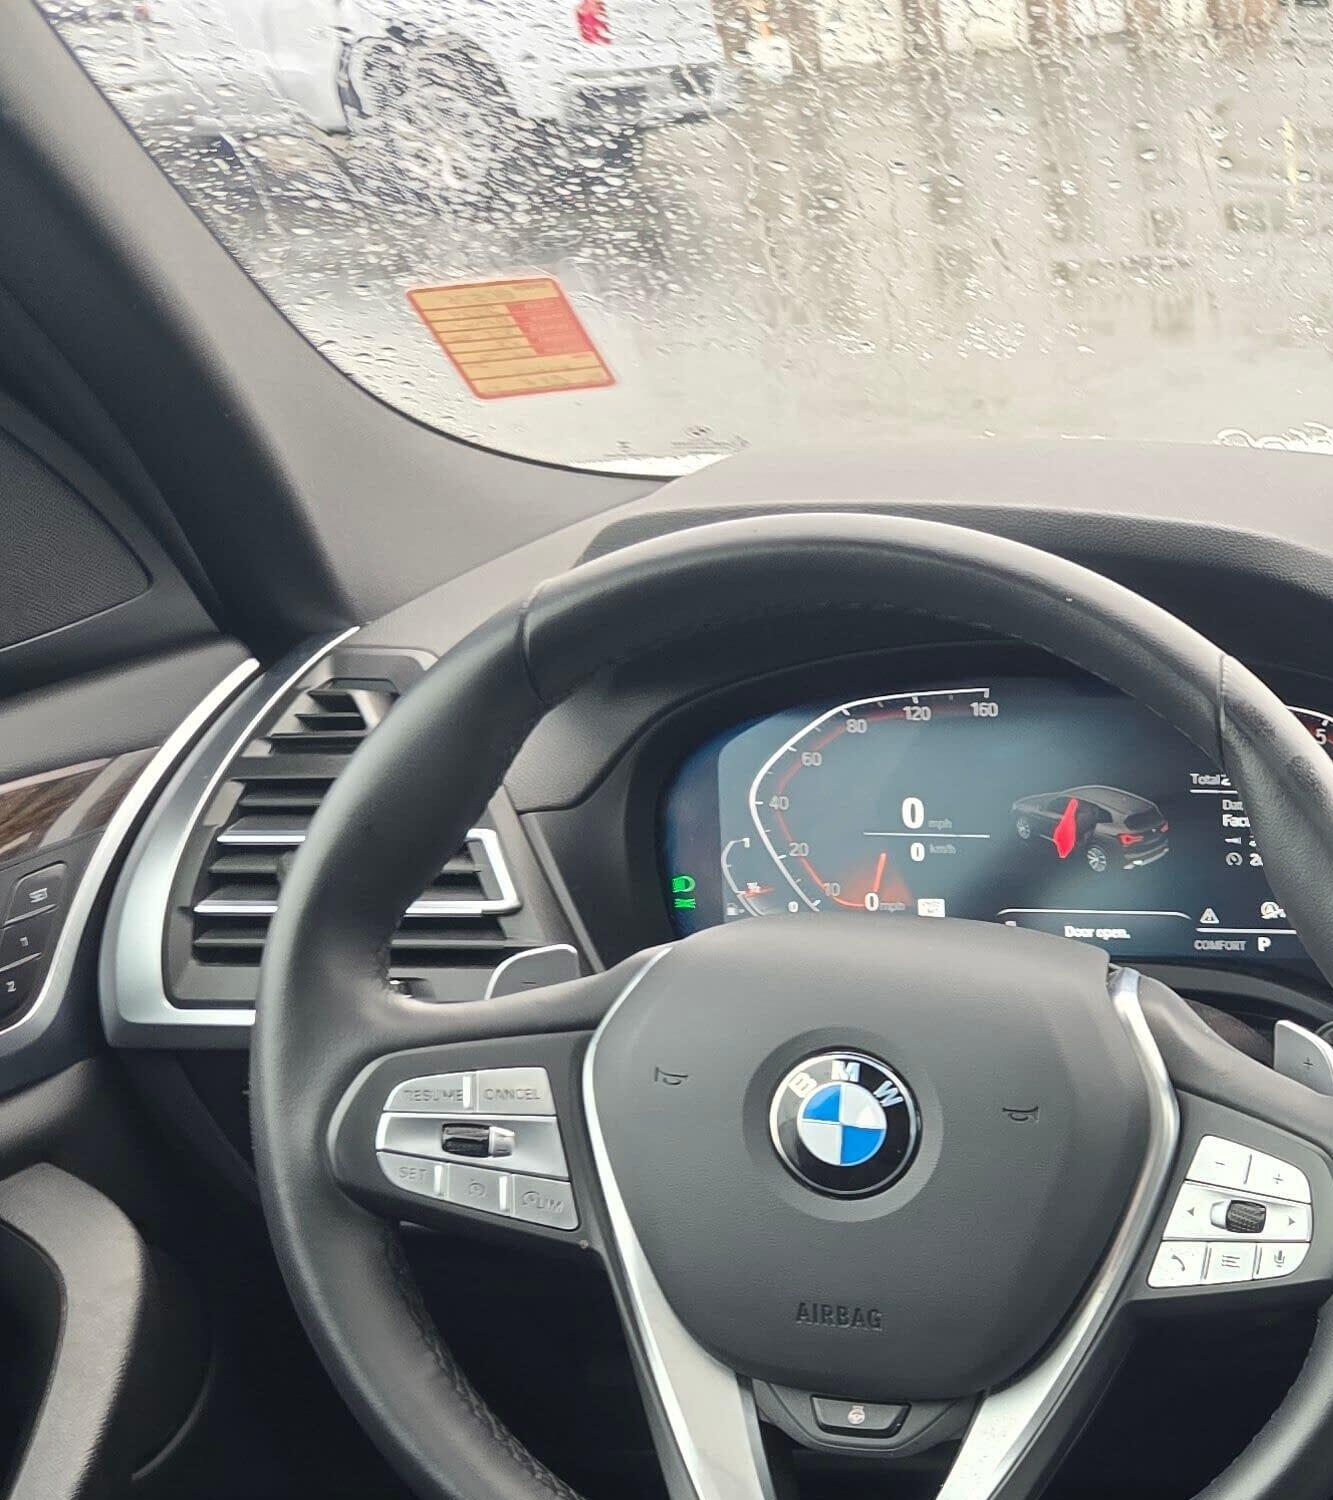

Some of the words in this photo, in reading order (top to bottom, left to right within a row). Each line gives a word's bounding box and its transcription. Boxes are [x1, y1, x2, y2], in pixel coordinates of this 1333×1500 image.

[902, 706, 931, 721] 120
[969, 702, 999, 718] 160
[845, 718, 867, 734] 80
[1315, 728, 1328, 745] 5
[801, 752, 822, 767] 60
[768, 795, 789, 810] 40
[902, 797, 925, 829] 0
[788, 842, 809, 858] 20
[910, 842, 926, 861] 0
[824, 882, 841, 897] 10
[864, 892, 879, 912] 0
[1194, 939, 1247, 951] COMFORT
[1257, 936, 1272, 952] P
[786, 1059, 905, 1108] BMW
[482, 1087, 542, 1101] CANCEL
[399, 1165, 427, 1181] SET
[795, 1301, 884, 1332] AIRBAG
